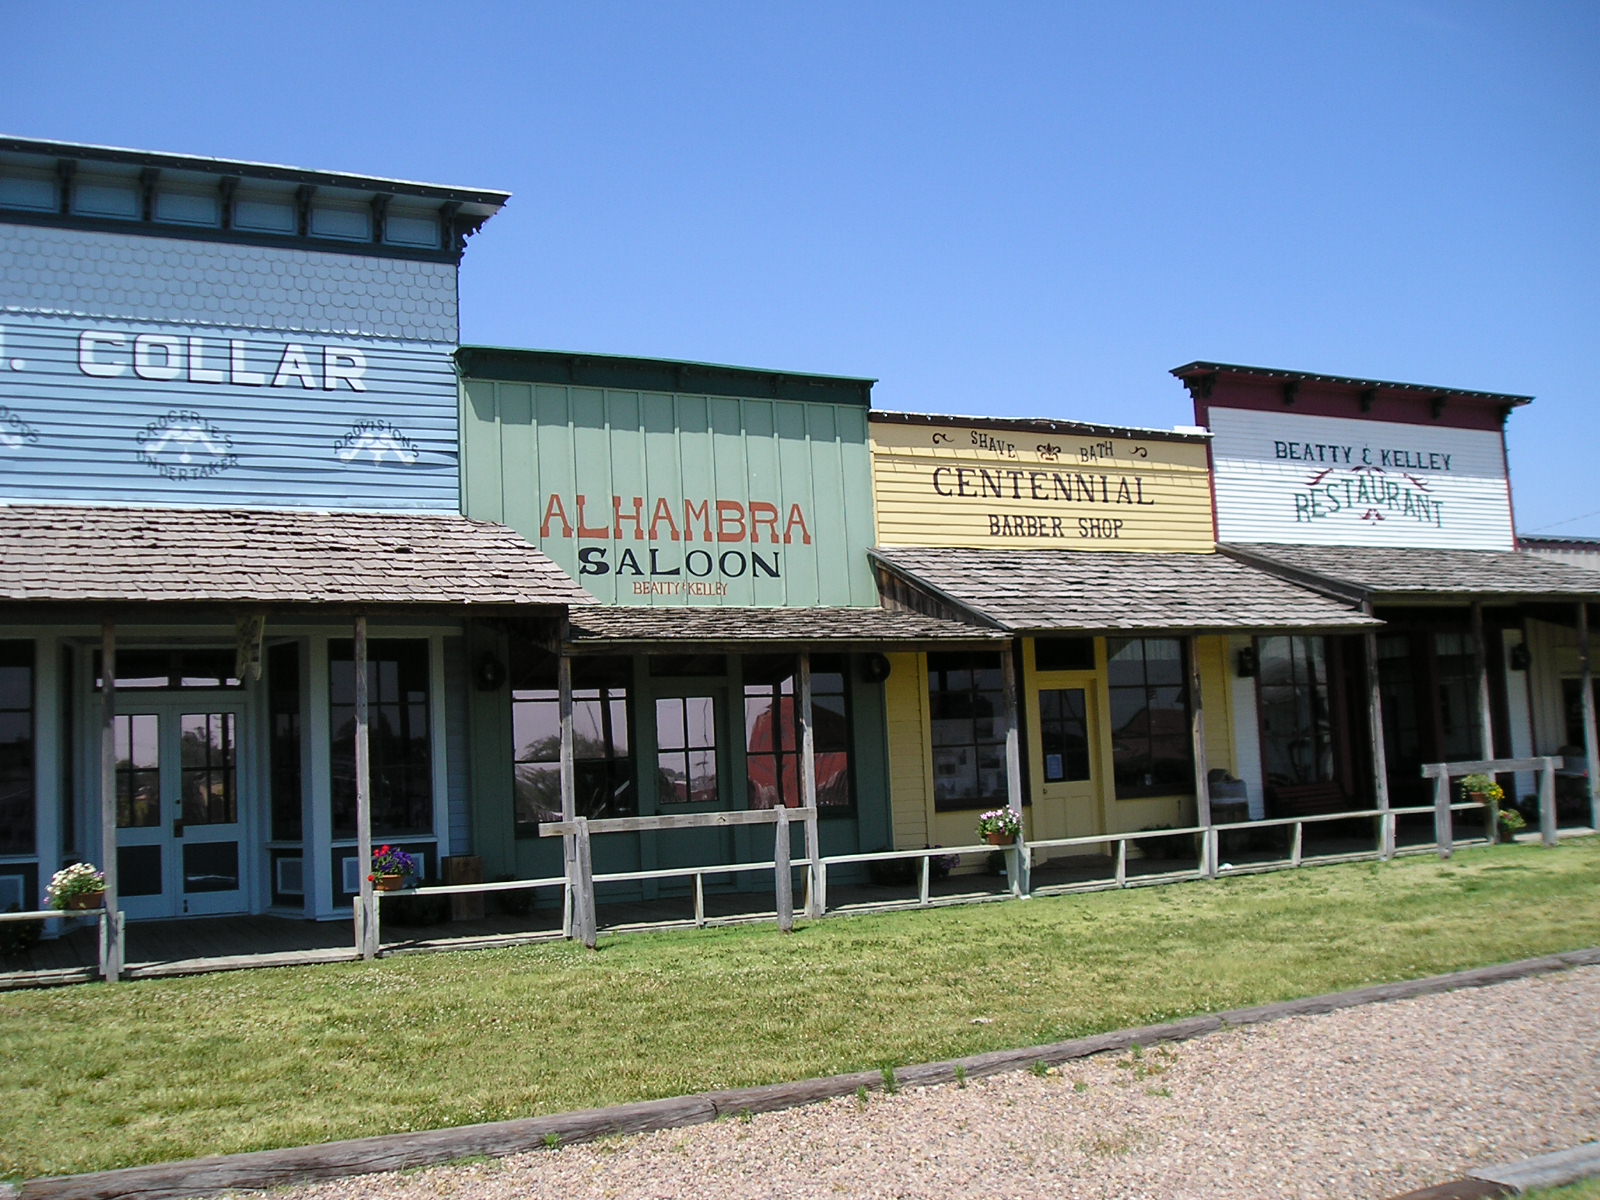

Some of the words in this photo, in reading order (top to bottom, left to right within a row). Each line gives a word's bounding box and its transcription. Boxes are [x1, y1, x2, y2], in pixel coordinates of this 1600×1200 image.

[78, 330, 368, 393] COLLAR
[136, 410, 234, 449] GROCERIES
[333, 418, 420, 459] PROVISIONS
[971, 431, 1015, 458] SHAVE
[136, 451, 240, 482] UNDERTAKER
[1080, 441, 1114, 463] BATH
[1274, 441, 1352, 463] BEATTY
[1381, 449, 1450, 471] KELLEY
[932, 467, 1155, 505] CENTENNIAL
[1293, 474, 1443, 528] RESTAURANT
[540, 494, 812, 545] ALHAMBRA
[988, 514, 1065, 538] BARBER
[1079, 518, 1124, 539] SHOP
[578, 547, 781, 578] SALOON
[633, 581, 680, 595] BEATTY
[688, 581, 728, 596] KELLEY
